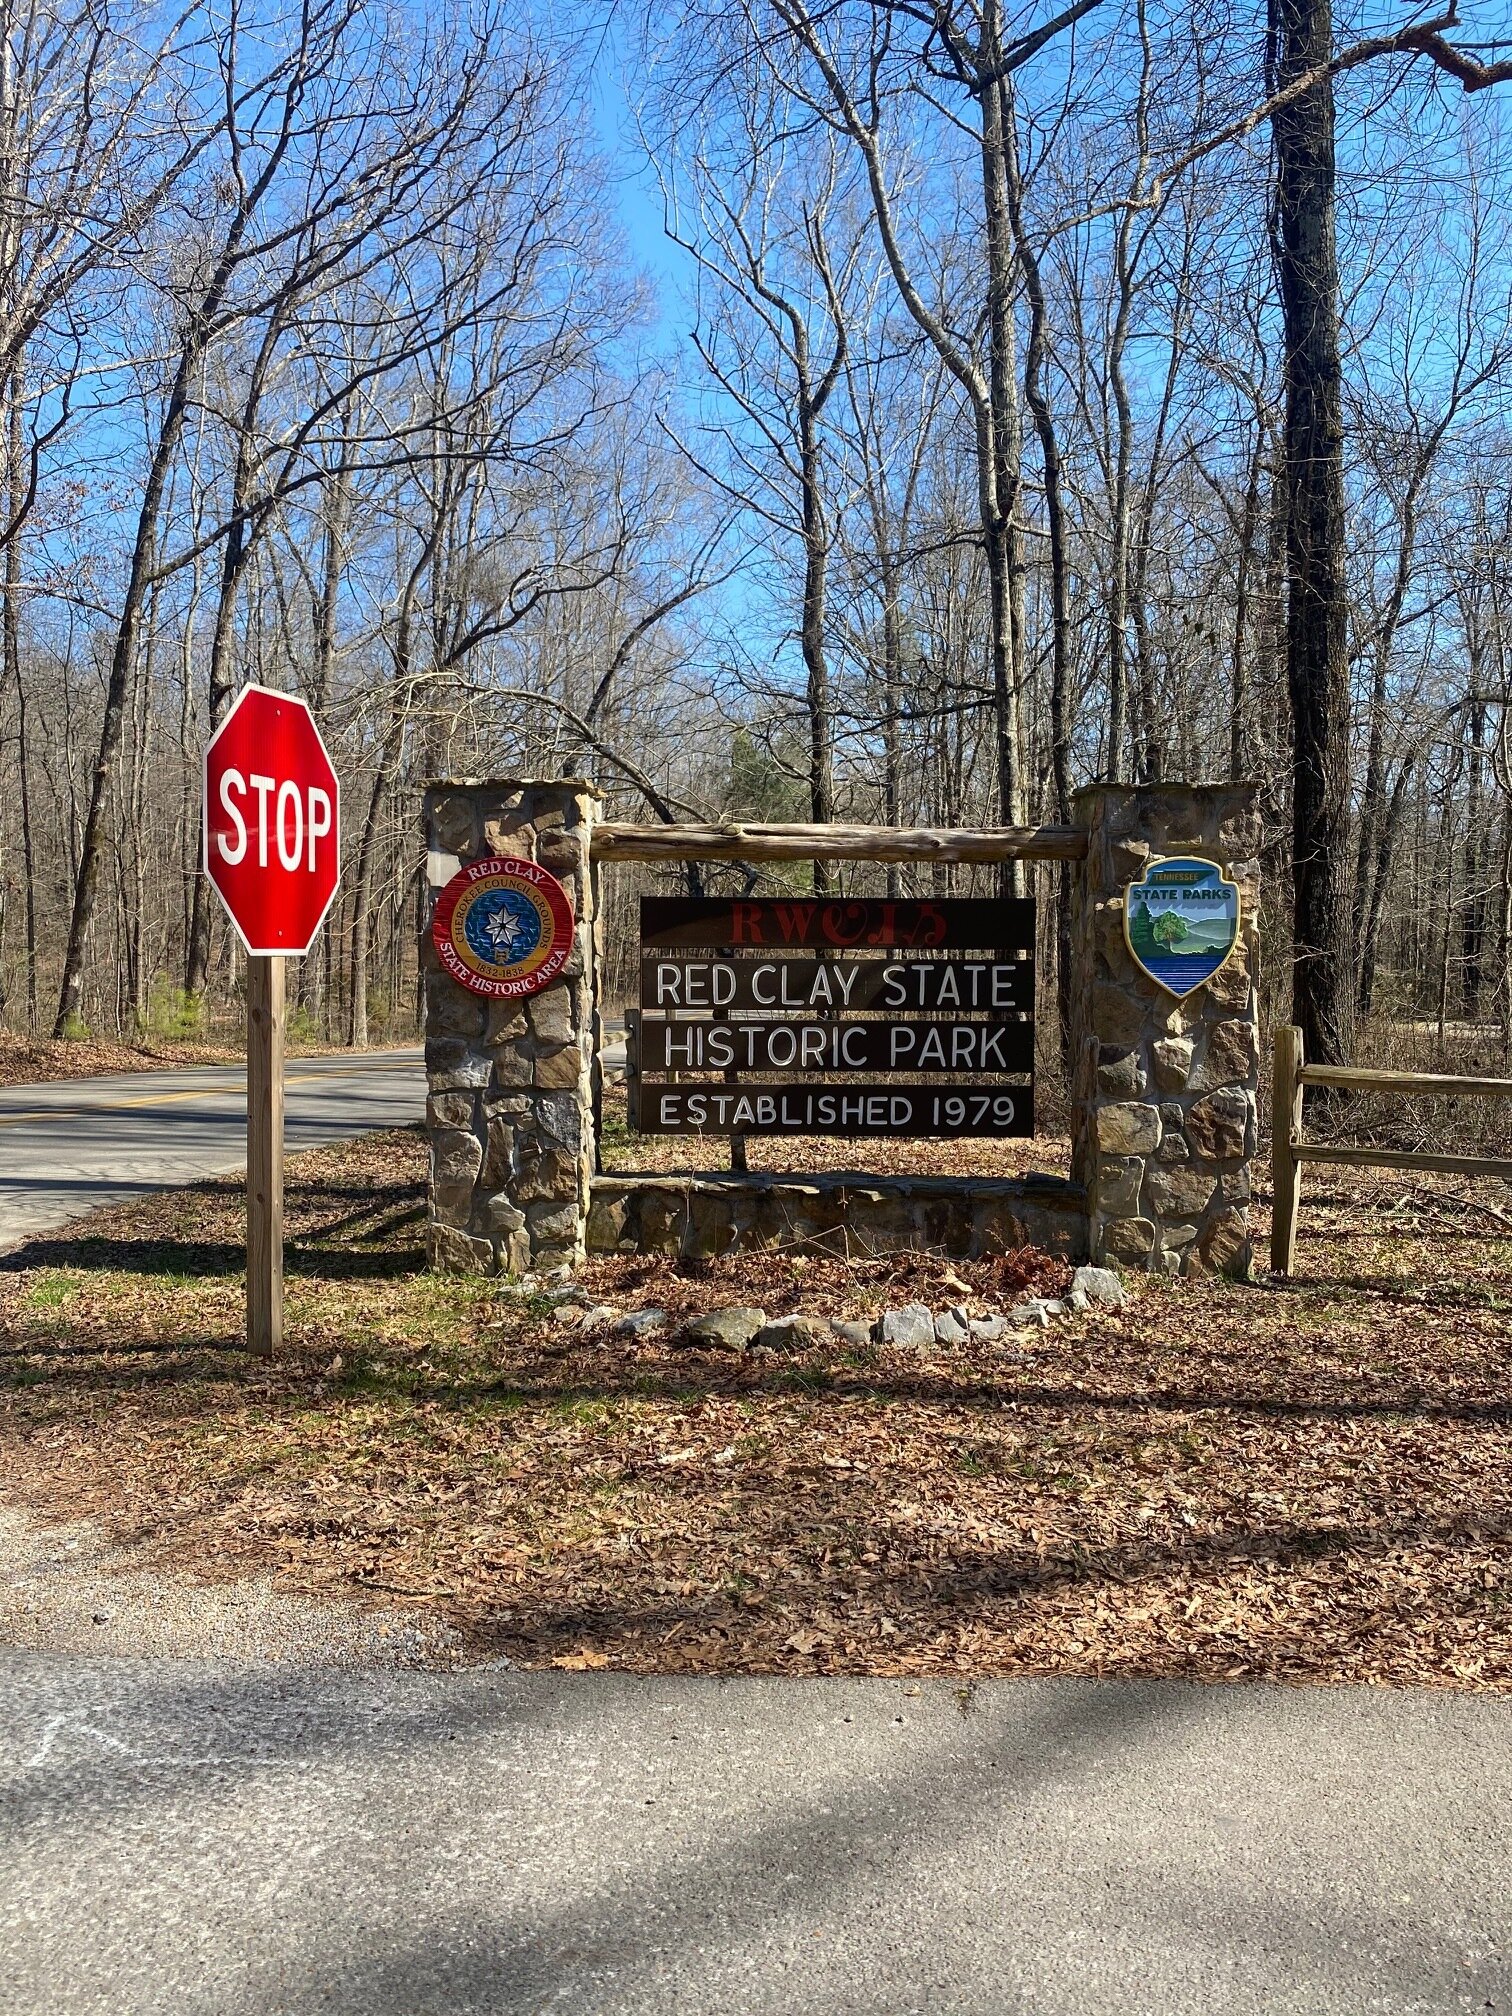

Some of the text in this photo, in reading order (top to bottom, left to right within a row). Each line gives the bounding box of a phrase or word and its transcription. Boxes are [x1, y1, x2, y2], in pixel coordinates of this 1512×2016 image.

[217, 768, 331, 872] STOP
[468, 861, 545, 884] RED CLAY
[1154, 873, 1199, 881] TENNESSEE
[1133, 889, 1231, 899] STATE PARKS
[454, 879, 552, 950] CHEROKEE COUNCIL GROUNDS
[440, 942, 566, 995] STATE HISTORIC AREA
[475, 963, 525, 978] 1832-1838
[657, 963, 1017, 1007] RED CLAY STATE
[665, 1026, 1007, 1068] HISTORIC PARK
[660, 1095, 1015, 1126] ESTABLISHED 1979
